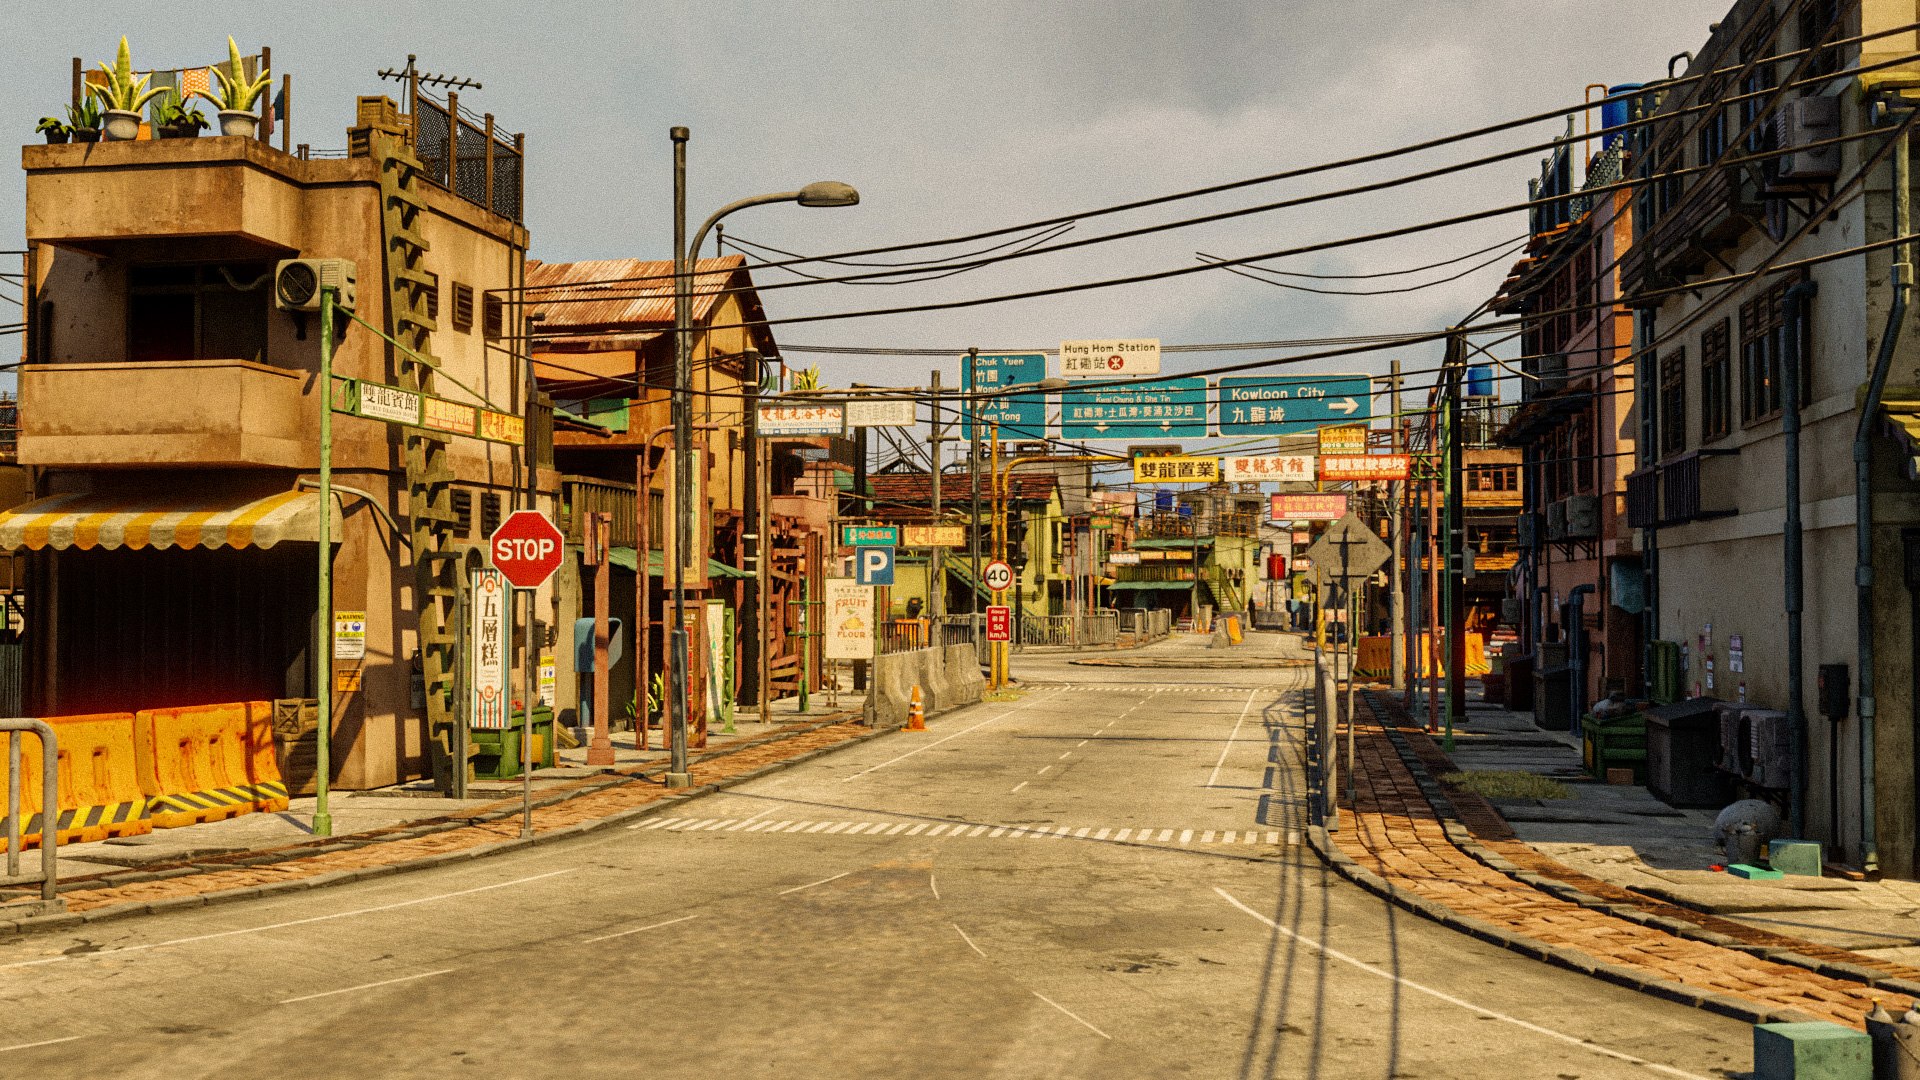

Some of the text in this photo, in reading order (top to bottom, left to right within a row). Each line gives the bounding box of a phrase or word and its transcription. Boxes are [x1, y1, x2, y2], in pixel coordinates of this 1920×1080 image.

[1064, 343, 1156, 355] Hung Hom Station
[976, 357, 1025, 367] Chuk Yuen
[363, 383, 418, 413] 雙龍賓館
[1232, 386, 1325, 402] Kowloon City
[760, 406, 843, 422] 雙龍洗浴中心
[1000, 411, 1021, 422] Tong
[1140, 461, 1215, 479] 雙龍置業
[1234, 457, 1305, 474] 雙龍賓館
[496, 538, 555, 561] STOP
[863, 550, 888, 582] P
[987, 569, 1009, 582] 40
[835, 597, 868, 616] FRUIT
[481, 593, 499, 667] 五層糕
[837, 631, 867, 639] FLOUR
[989, 631, 1008, 639] km/h
[992, 623, 1004, 631] 50
